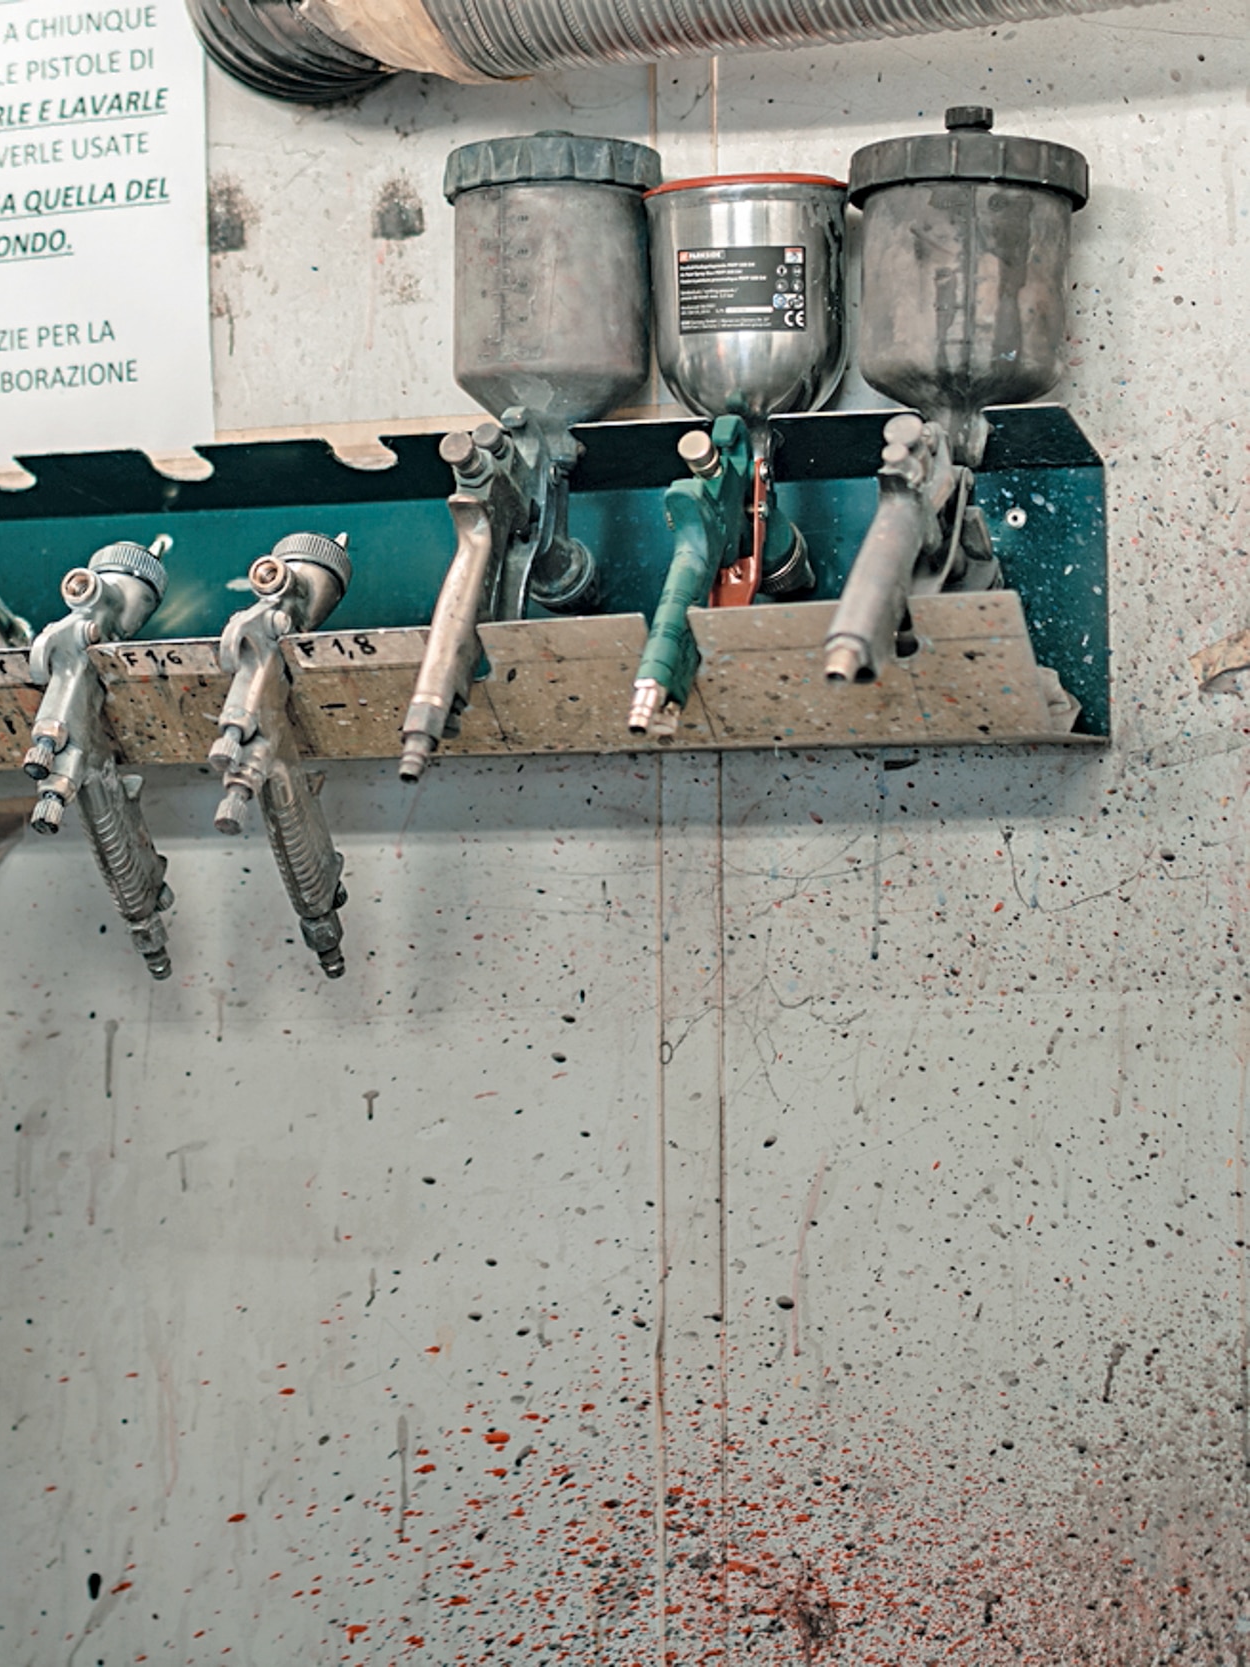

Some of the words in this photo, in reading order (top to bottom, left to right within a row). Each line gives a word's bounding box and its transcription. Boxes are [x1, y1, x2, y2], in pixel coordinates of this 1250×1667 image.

[4, 23, 18, 43] A
[26, 5, 157, 40] CHIUNQUE
[27, 50, 121, 81] PISTOLE
[130, 48, 153, 71] DI
[38, 100, 51, 122] E
[59, 88, 168, 119] LAVARLE
[72, 132, 149, 160] USATE
[24, 182, 116, 215] QUELLA
[126, 177, 169, 203] DEL
[37, 323, 81, 348] PER
[88, 320, 116, 344] LA
[123, 651, 138, 667] F
